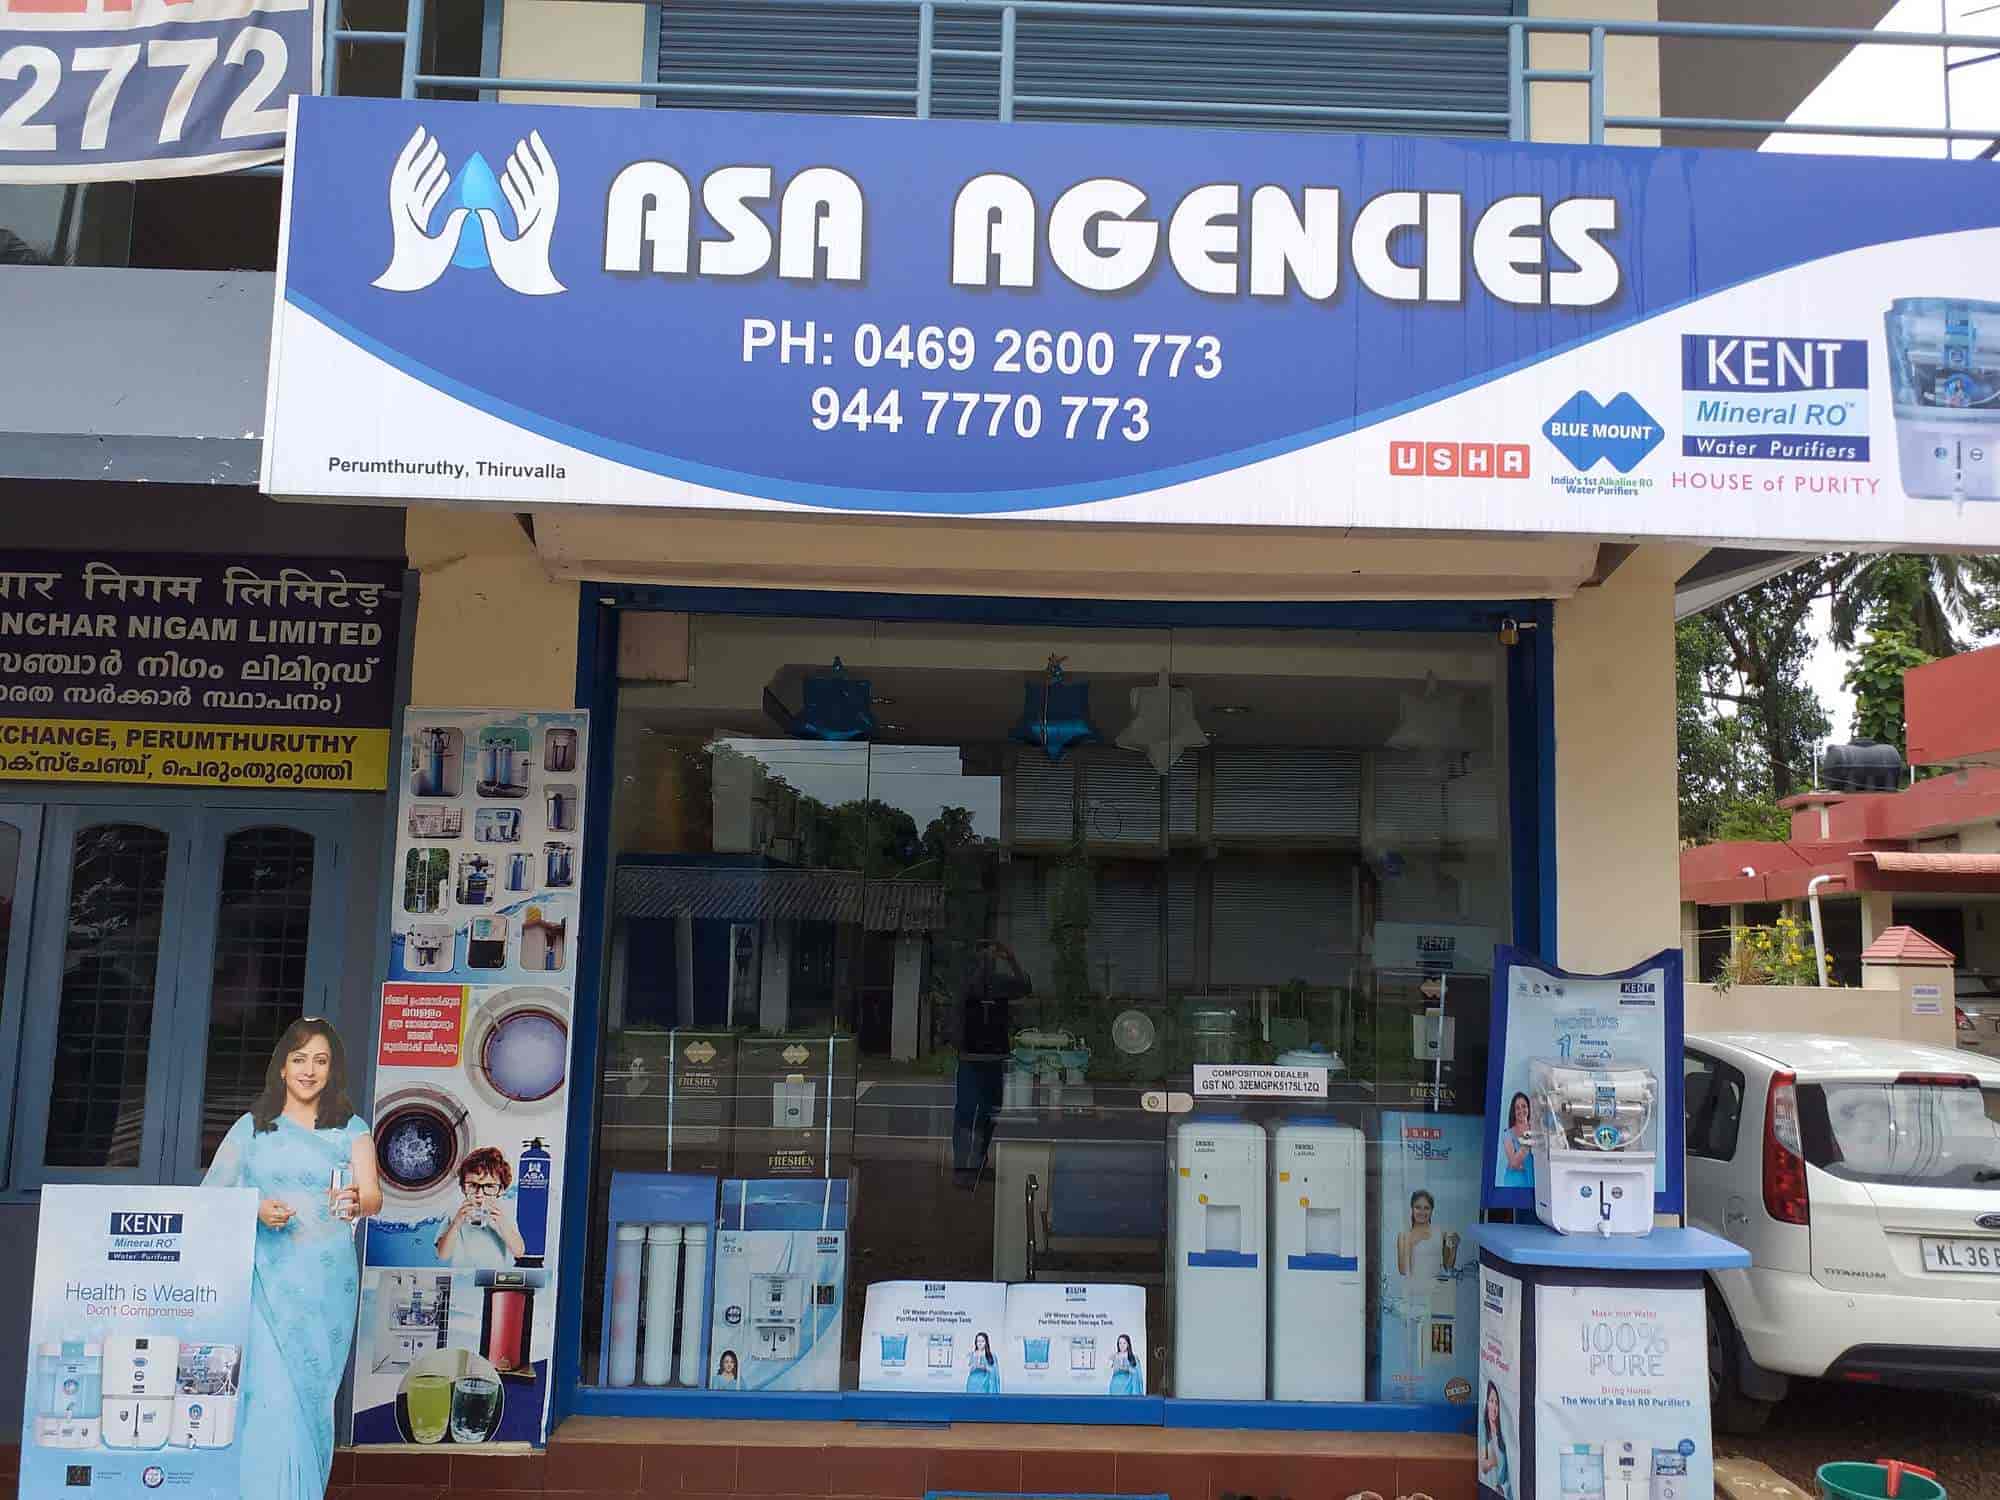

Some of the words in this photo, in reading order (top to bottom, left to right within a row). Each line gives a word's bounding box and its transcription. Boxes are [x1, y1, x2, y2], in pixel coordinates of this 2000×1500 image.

[0, 27, 288, 150] 2772
[604, 160, 864, 281] ASA
[952, 173, 1620, 306] AGENCIES
[742, 319, 834, 367] PH:
[853, 323, 976, 371] 0469
[993, 328, 1115, 375] 2600
[1133, 333, 1223, 379] 773
[1708, 339, 1842, 387] KENT
[811, 386, 903, 433] 944
[921, 391, 1041, 439] 7770
[1061, 396, 1151, 442] 773
[1696, 400, 1796, 424] Mineral
[1552, 422, 1589, 437] BLUE
[1593, 424, 1652, 440] MOUNT
[1696, 437, 1757, 455] Water
[1770, 440, 1856, 459] Purifiers
[328, 457, 470, 479] Perumthuruthy,
[475, 461, 566, 480] Thiruvalla
[1395, 445, 1525, 475] USHA
[1551, 475, 1582, 486] India's
[1599, 477, 1637, 487] Alkaline
[1566, 485, 1596, 495] Water
[1598, 486, 1639, 496] Purifiers
[1672, 472, 1752, 490] HOUSE
[1763, 476, 1784, 491] of
[1795, 476, 1880, 494] PURITY
[82, 561, 202, 605] निगम
[0, 612, 117, 637] NCHAR
[128, 615, 238, 641] NIGAM
[248, 619, 382, 646] LIMITED
[138, 650, 224, 679] നിഗം
[0, 725, 117, 750] CHANGE,
[126, 728, 359, 754] PERUMTHURUTHY
[1202, 1080, 1219, 1090] GST
[1211, 1070, 1272, 1079] COMPOSITION
[1273, 1070, 1309, 1079] DEALER
[768, 1156, 815, 1167] FRESHEN
[120, 1214, 173, 1233] KENT
[114, 1238, 153, 1248] Mineral
[1936, 1244, 1961, 1266] KL
[1966, 1247, 1989, 1267] 36
[65, 1282, 125, 1301] Health
[132, 1284, 147, 1301] is
[152, 1284, 217, 1303] Wealth
[87, 1304, 117, 1315] Don't
[120, 1305, 194, 1318] Compromise
[1581, 1322, 1669, 1354] 100%
[1590, 1354, 1664, 1376] PURE
[1560, 1396, 1577, 1406] The
[1579, 1396, 1614, 1406] World's
